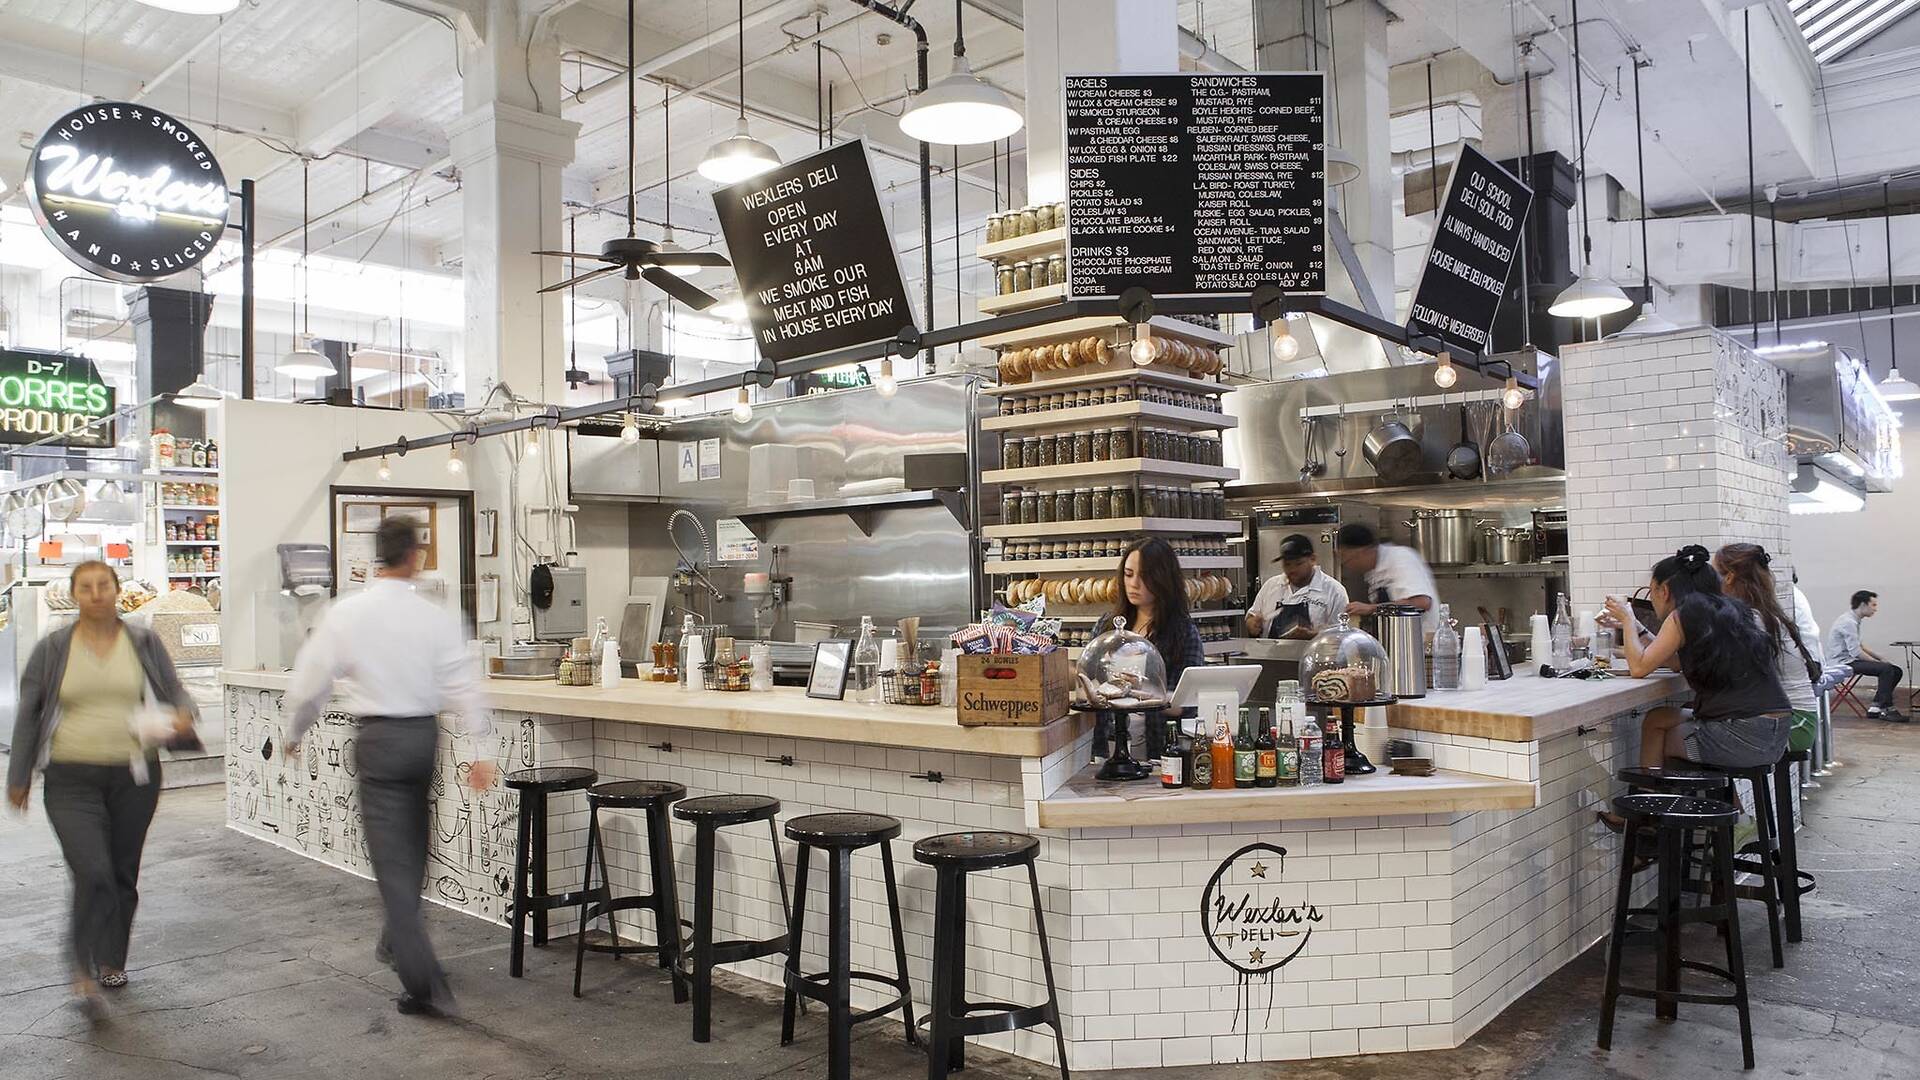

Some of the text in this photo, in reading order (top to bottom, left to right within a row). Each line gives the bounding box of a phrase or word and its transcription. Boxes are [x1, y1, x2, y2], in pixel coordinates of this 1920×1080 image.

[1067, 79, 1107, 88] BAGELS
[1191, 78, 1257, 87] SANDWICHES
[1143, 89, 1152, 97] $3
[1168, 98, 1177, 106] $9
[1196, 98, 1235, 106] MUSTARD,
[1116, 108, 1159, 116] STURGEON
[1196, 117, 1235, 125] MUSTARD,
[1237, 116, 1253, 124] RYE
[58, 108, 211, 170] HOUSE SMOKED
[1278, 135, 1310, 143] CHEESE,
[1070, 169, 1099, 178] SIDES
[743, 165, 838, 210] WEXLERS DELI
[1470, 172, 1511, 210] OLD SCHOOL
[768, 201, 807, 225] OPEN
[1071, 208, 1115, 216] COLESLAW
[1460, 188, 1514, 231] DELI SOUL FOOD
[764, 211, 838, 247] EVERY DAY
[1071, 217, 1120, 225] CHOCOLATE
[1444, 215, 1472, 241] ALWAYS
[53, 210, 121, 264] HAND
[152, 231, 212, 270] SLICED
[796, 240, 812, 257] AT
[1072, 247, 1112, 256] DRINKS
[794, 256, 824, 276] 8AM
[1072, 256, 1171, 266] CHOCOLATE PHOSPHATE
[1200, 263, 1240, 271] TOASTED
[1073, 267, 1122, 275] CHOCOLATE
[1430, 248, 1504, 296] HOUSE MADE DELI PICKLES
[759, 264, 867, 304] WE SMOKE OUR
[1073, 277, 1096, 285] SODA
[1073, 286, 1105, 294] COFFEE
[774, 285, 870, 322] MEAT AND FISH
[762, 298, 894, 343] IN HOUSE EVERY DAY
[1412, 304, 1440, 326] FOLLOW
[27, 360, 64, 375] D-7
[0, 376, 107, 412] ORRES
[0, 408, 100, 438] RODUCE
[683, 449, 693, 468] A
[964, 692, 1039, 718] Schweppes
[1214, 893, 1323, 924] Wexler's
[1241, 928, 1274, 941] DELI
